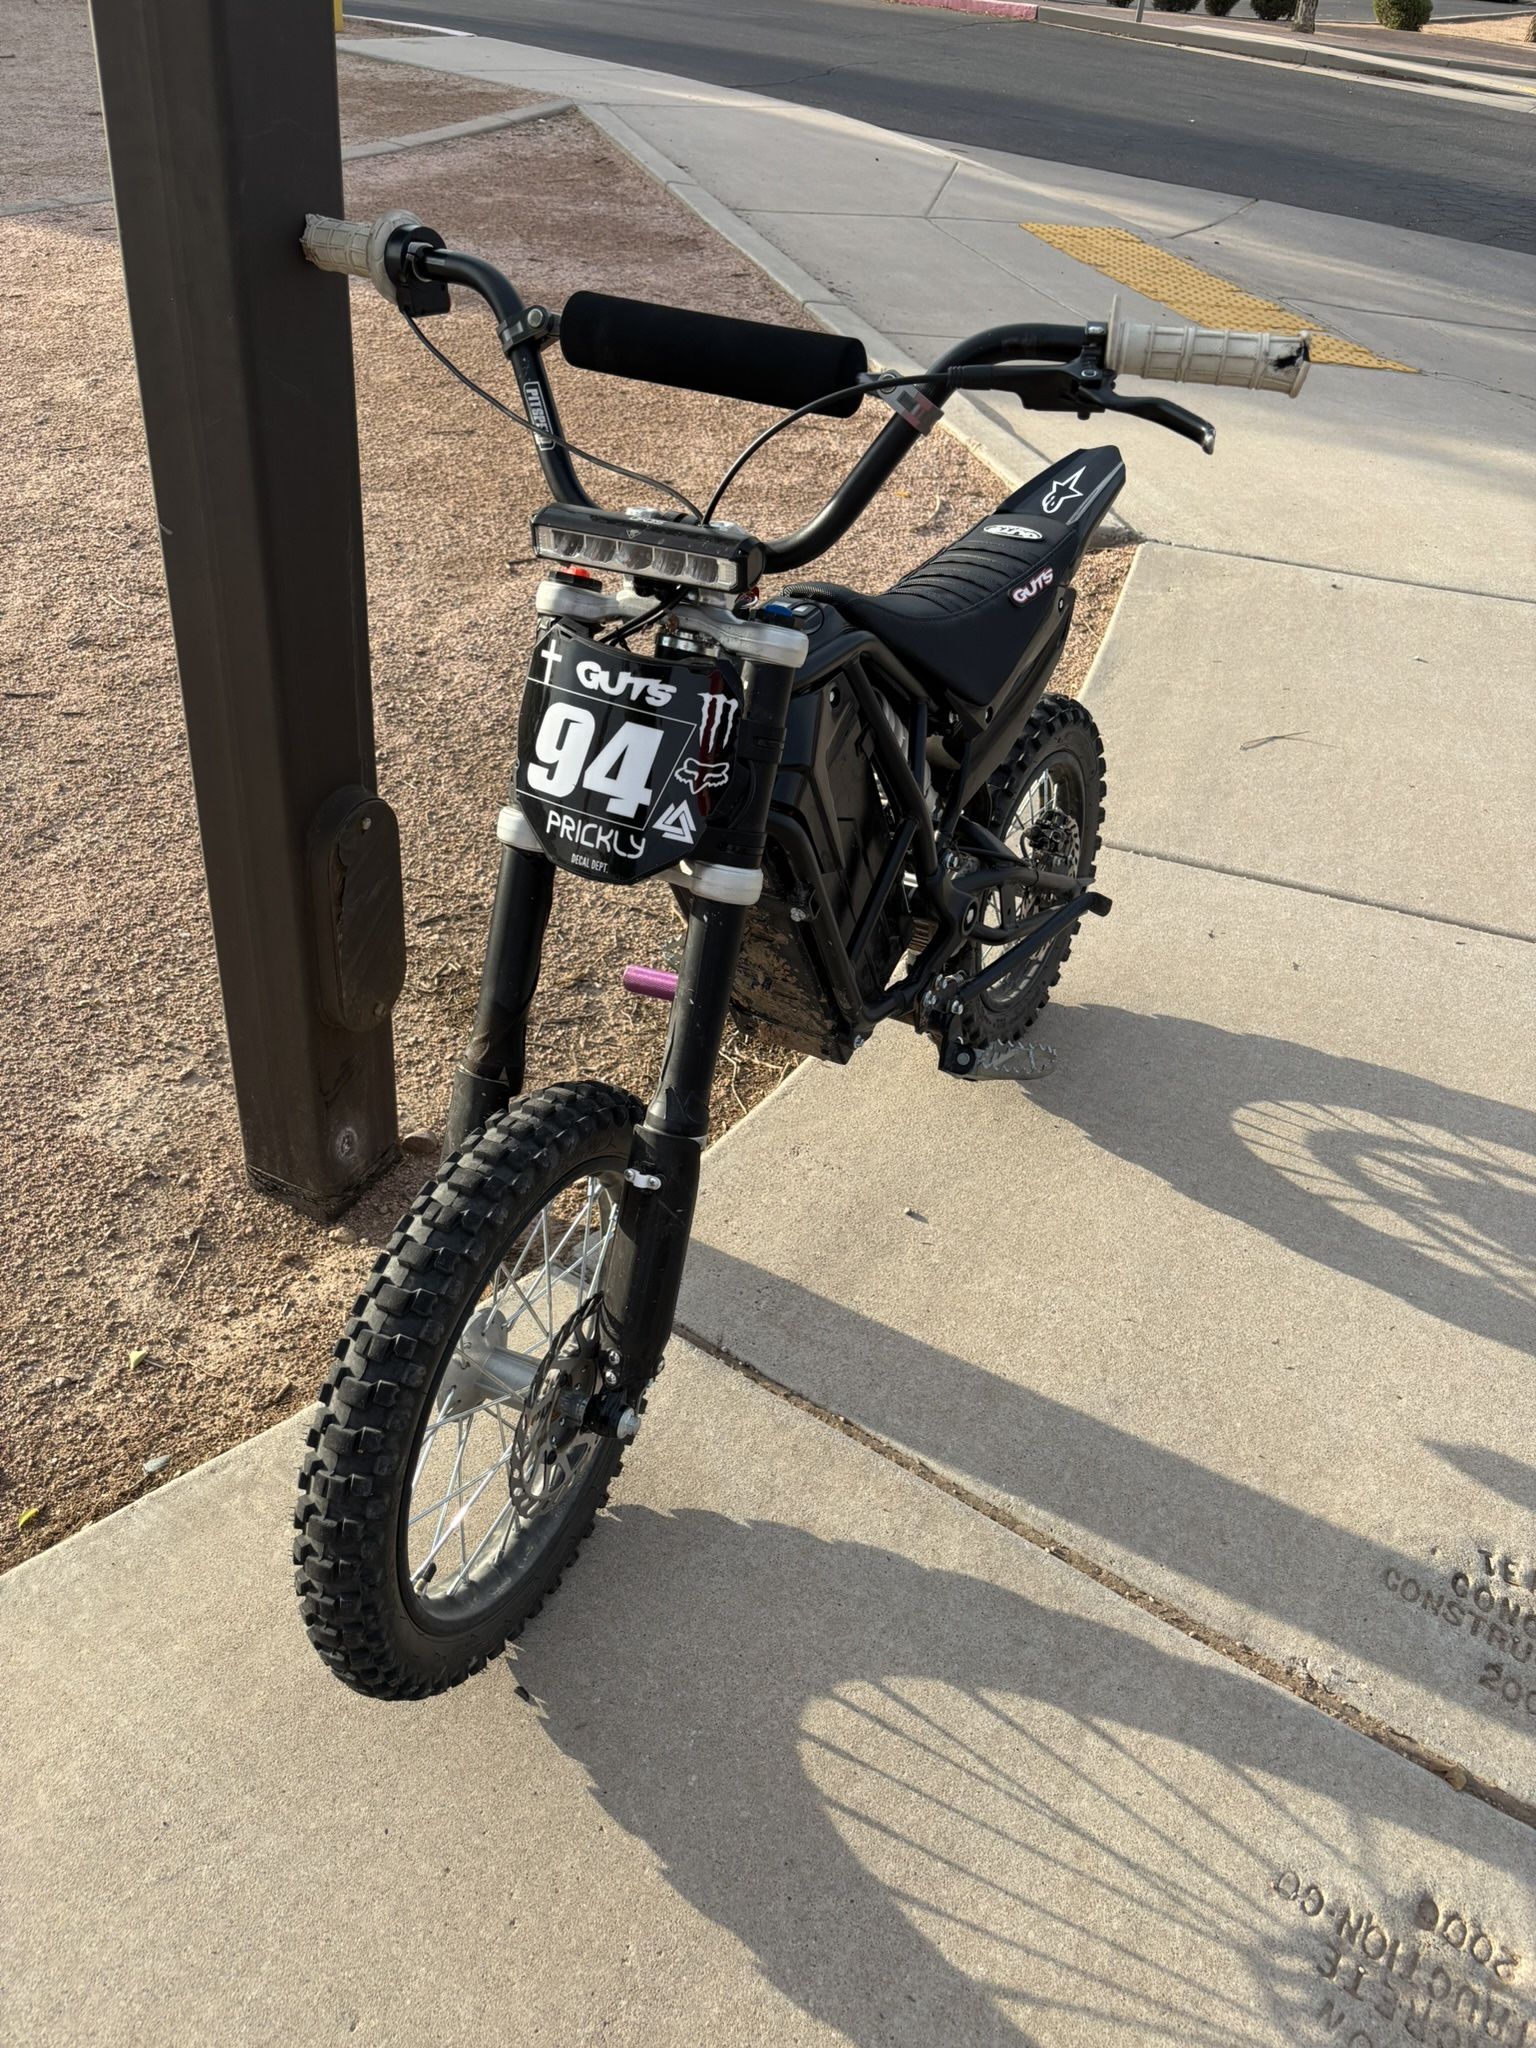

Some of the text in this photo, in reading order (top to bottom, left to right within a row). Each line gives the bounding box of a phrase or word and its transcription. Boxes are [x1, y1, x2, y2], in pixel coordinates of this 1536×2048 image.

[1012, 567, 1053, 603] GUTS
[575, 660, 677, 707] GUTS
[527, 702, 664, 819] 94
[546, 810, 646, 859] PRICKLY
[570, 852, 609, 874] DECAL DEPT.
